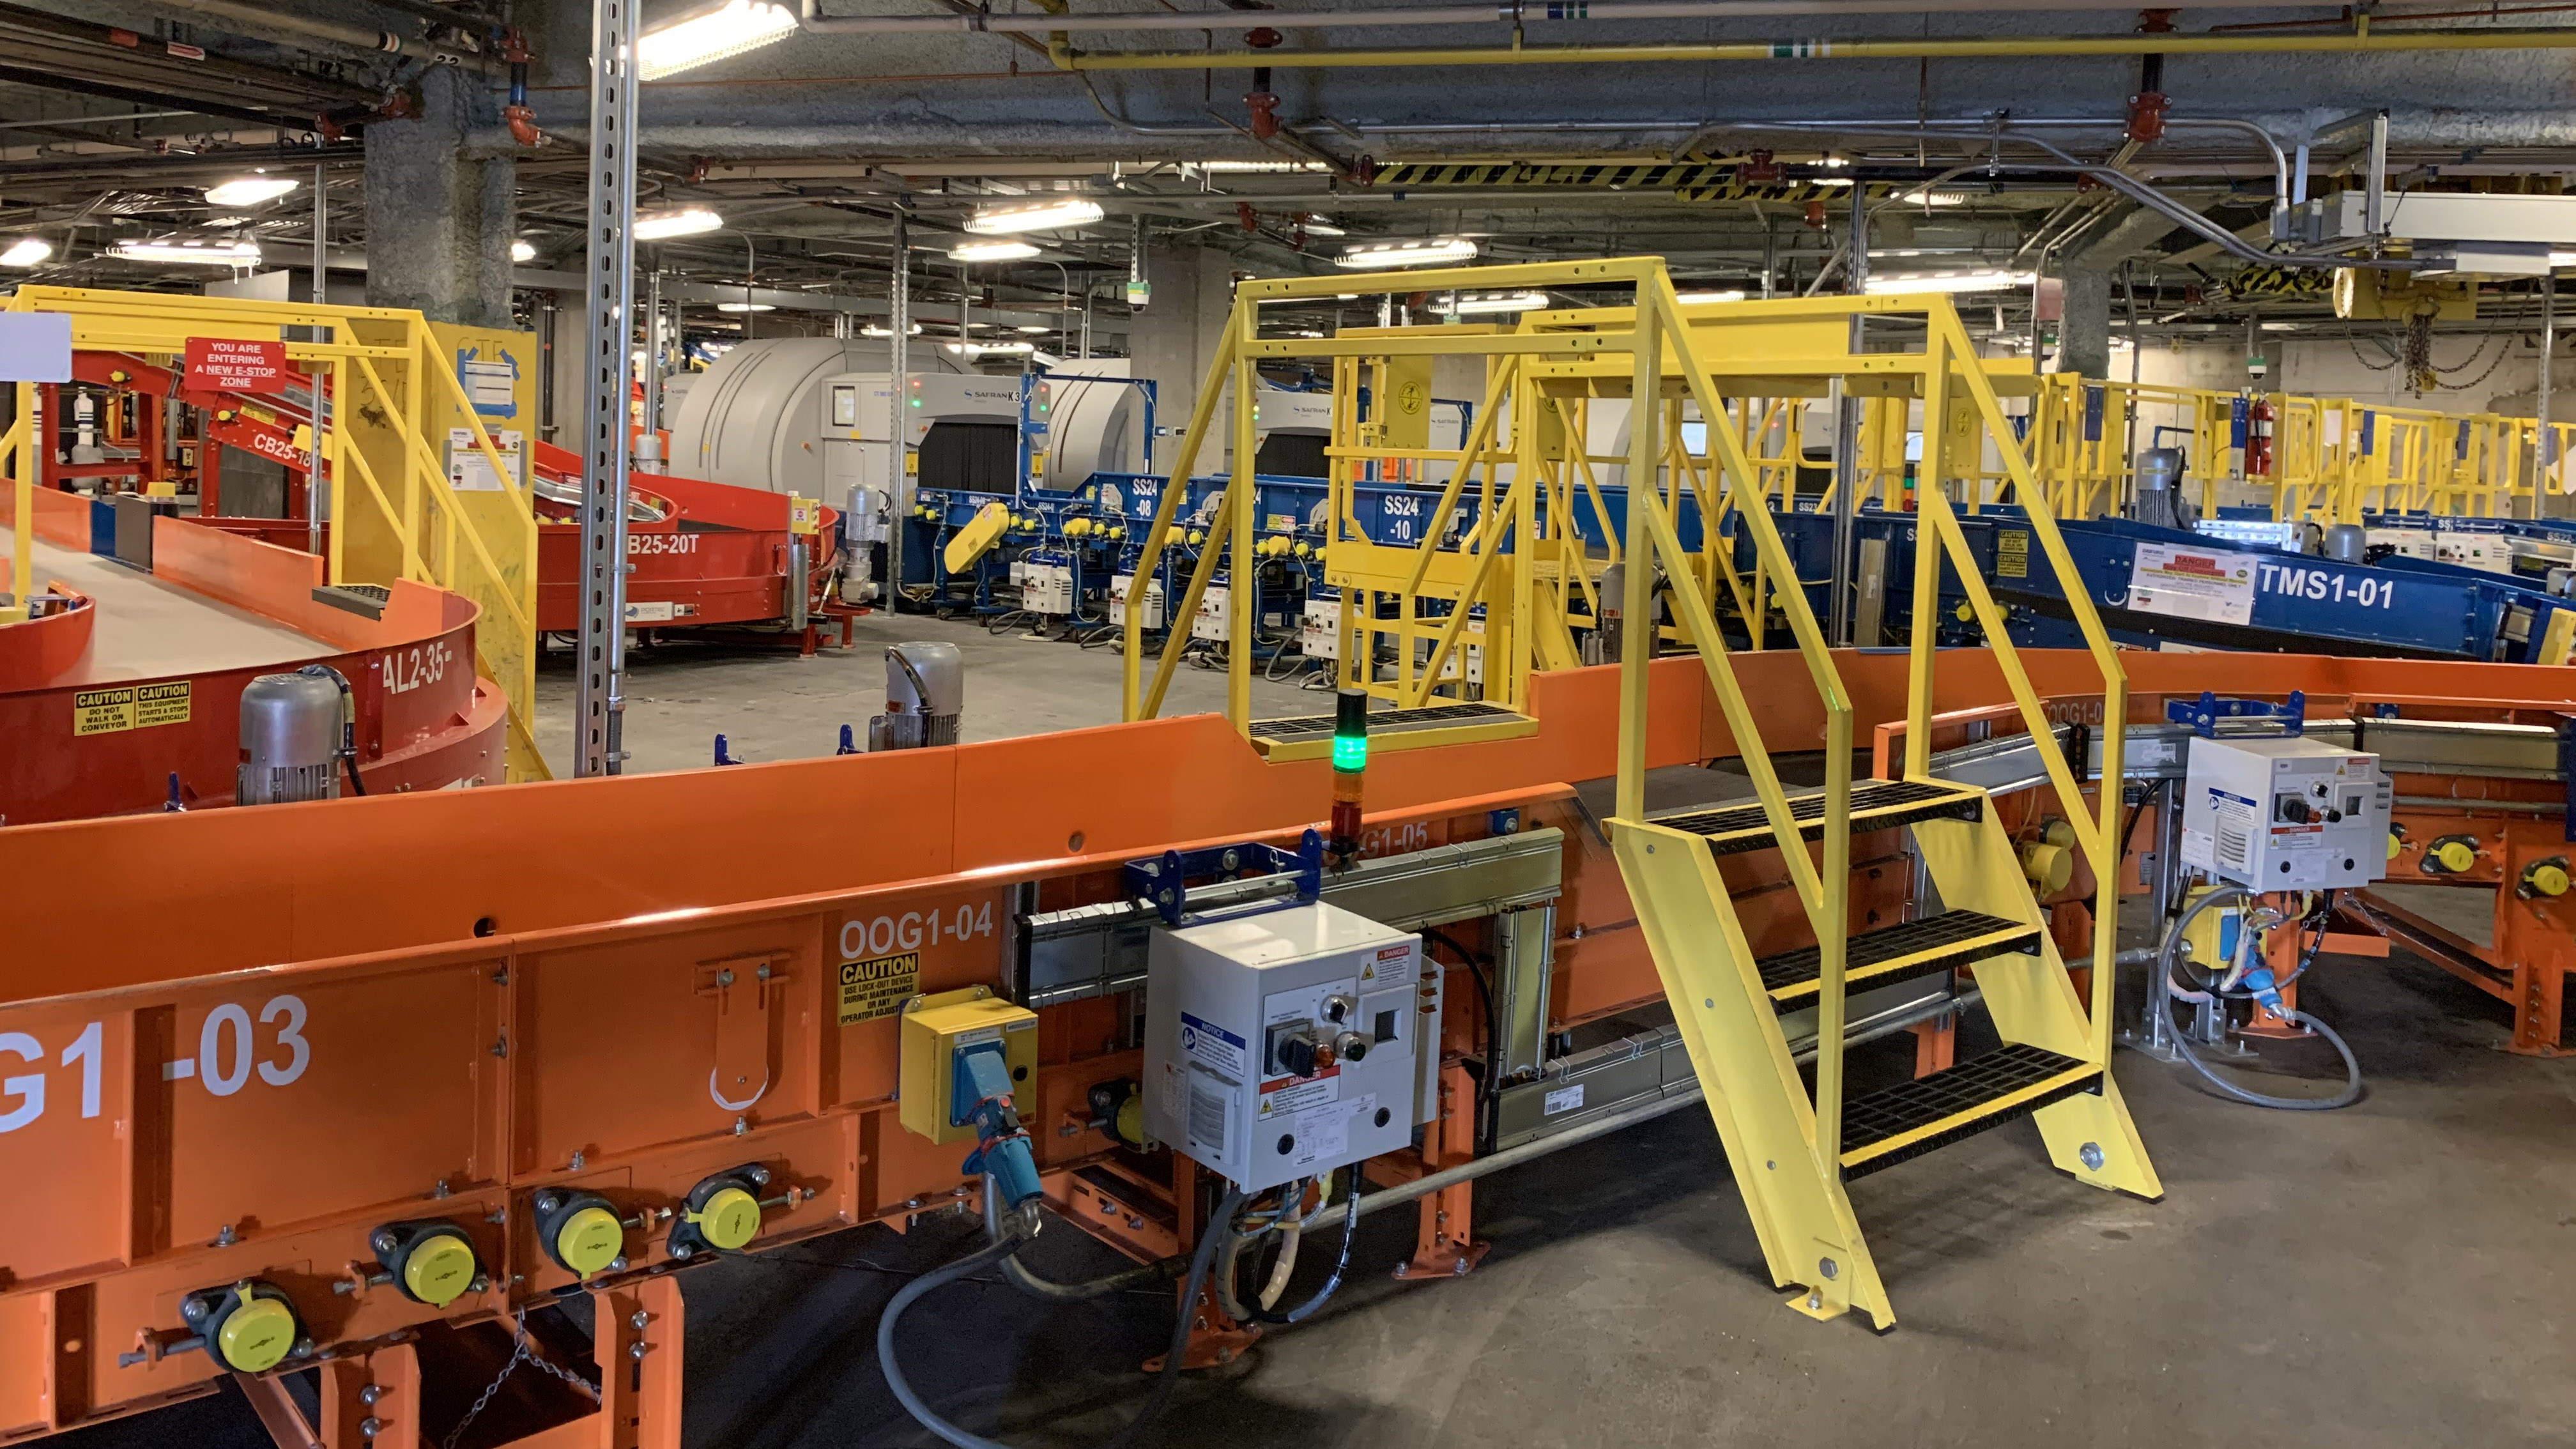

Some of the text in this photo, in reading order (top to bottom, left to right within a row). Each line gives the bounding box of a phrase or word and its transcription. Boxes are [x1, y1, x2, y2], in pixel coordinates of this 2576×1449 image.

[211, 342, 261, 353] YOU ARE
[207, 353, 264, 365] ENTERING
[195, 364, 276, 377] A NEW E-STOP
[220, 377, 251, 387] ZONE
[1133, 478, 1158, 496] SS24
[1135, 499, 1152, 517] -08
[1384, 494, 1420, 517] SS24
[1390, 520, 1411, 540] -10
[2175, 555, 2215, 569] DANGER
[2259, 564, 2394, 609] TMS1-01
[78, 691, 131, 707] CAUTION
[139, 684, 188, 700] CAUTION
[103, 706, 121, 714] NOT
[154, 698, 188, 707] EQUIPMENT
[86, 716, 109, 724] WALK
[139, 713, 188, 724] AUTOMATICALLY
[2048, 702, 2104, 724] OOG1-0
[81, 721, 127, 732] CONVEYOR
[839, 901, 993, 958] OOG1-04
[1384, 947, 1409, 958] DANGER
[841, 954, 916, 985] CAUTION
[844, 975, 914, 995] USE LOCK-OUT DEVICE
[844, 985, 914, 1004] DURING MAINTENANCE
[867, 999, 890, 1009] OR ANY
[841, 1005, 899, 1023] OPERATOR ADJUST
[1201, 1022, 1225, 1039] NOTICE
